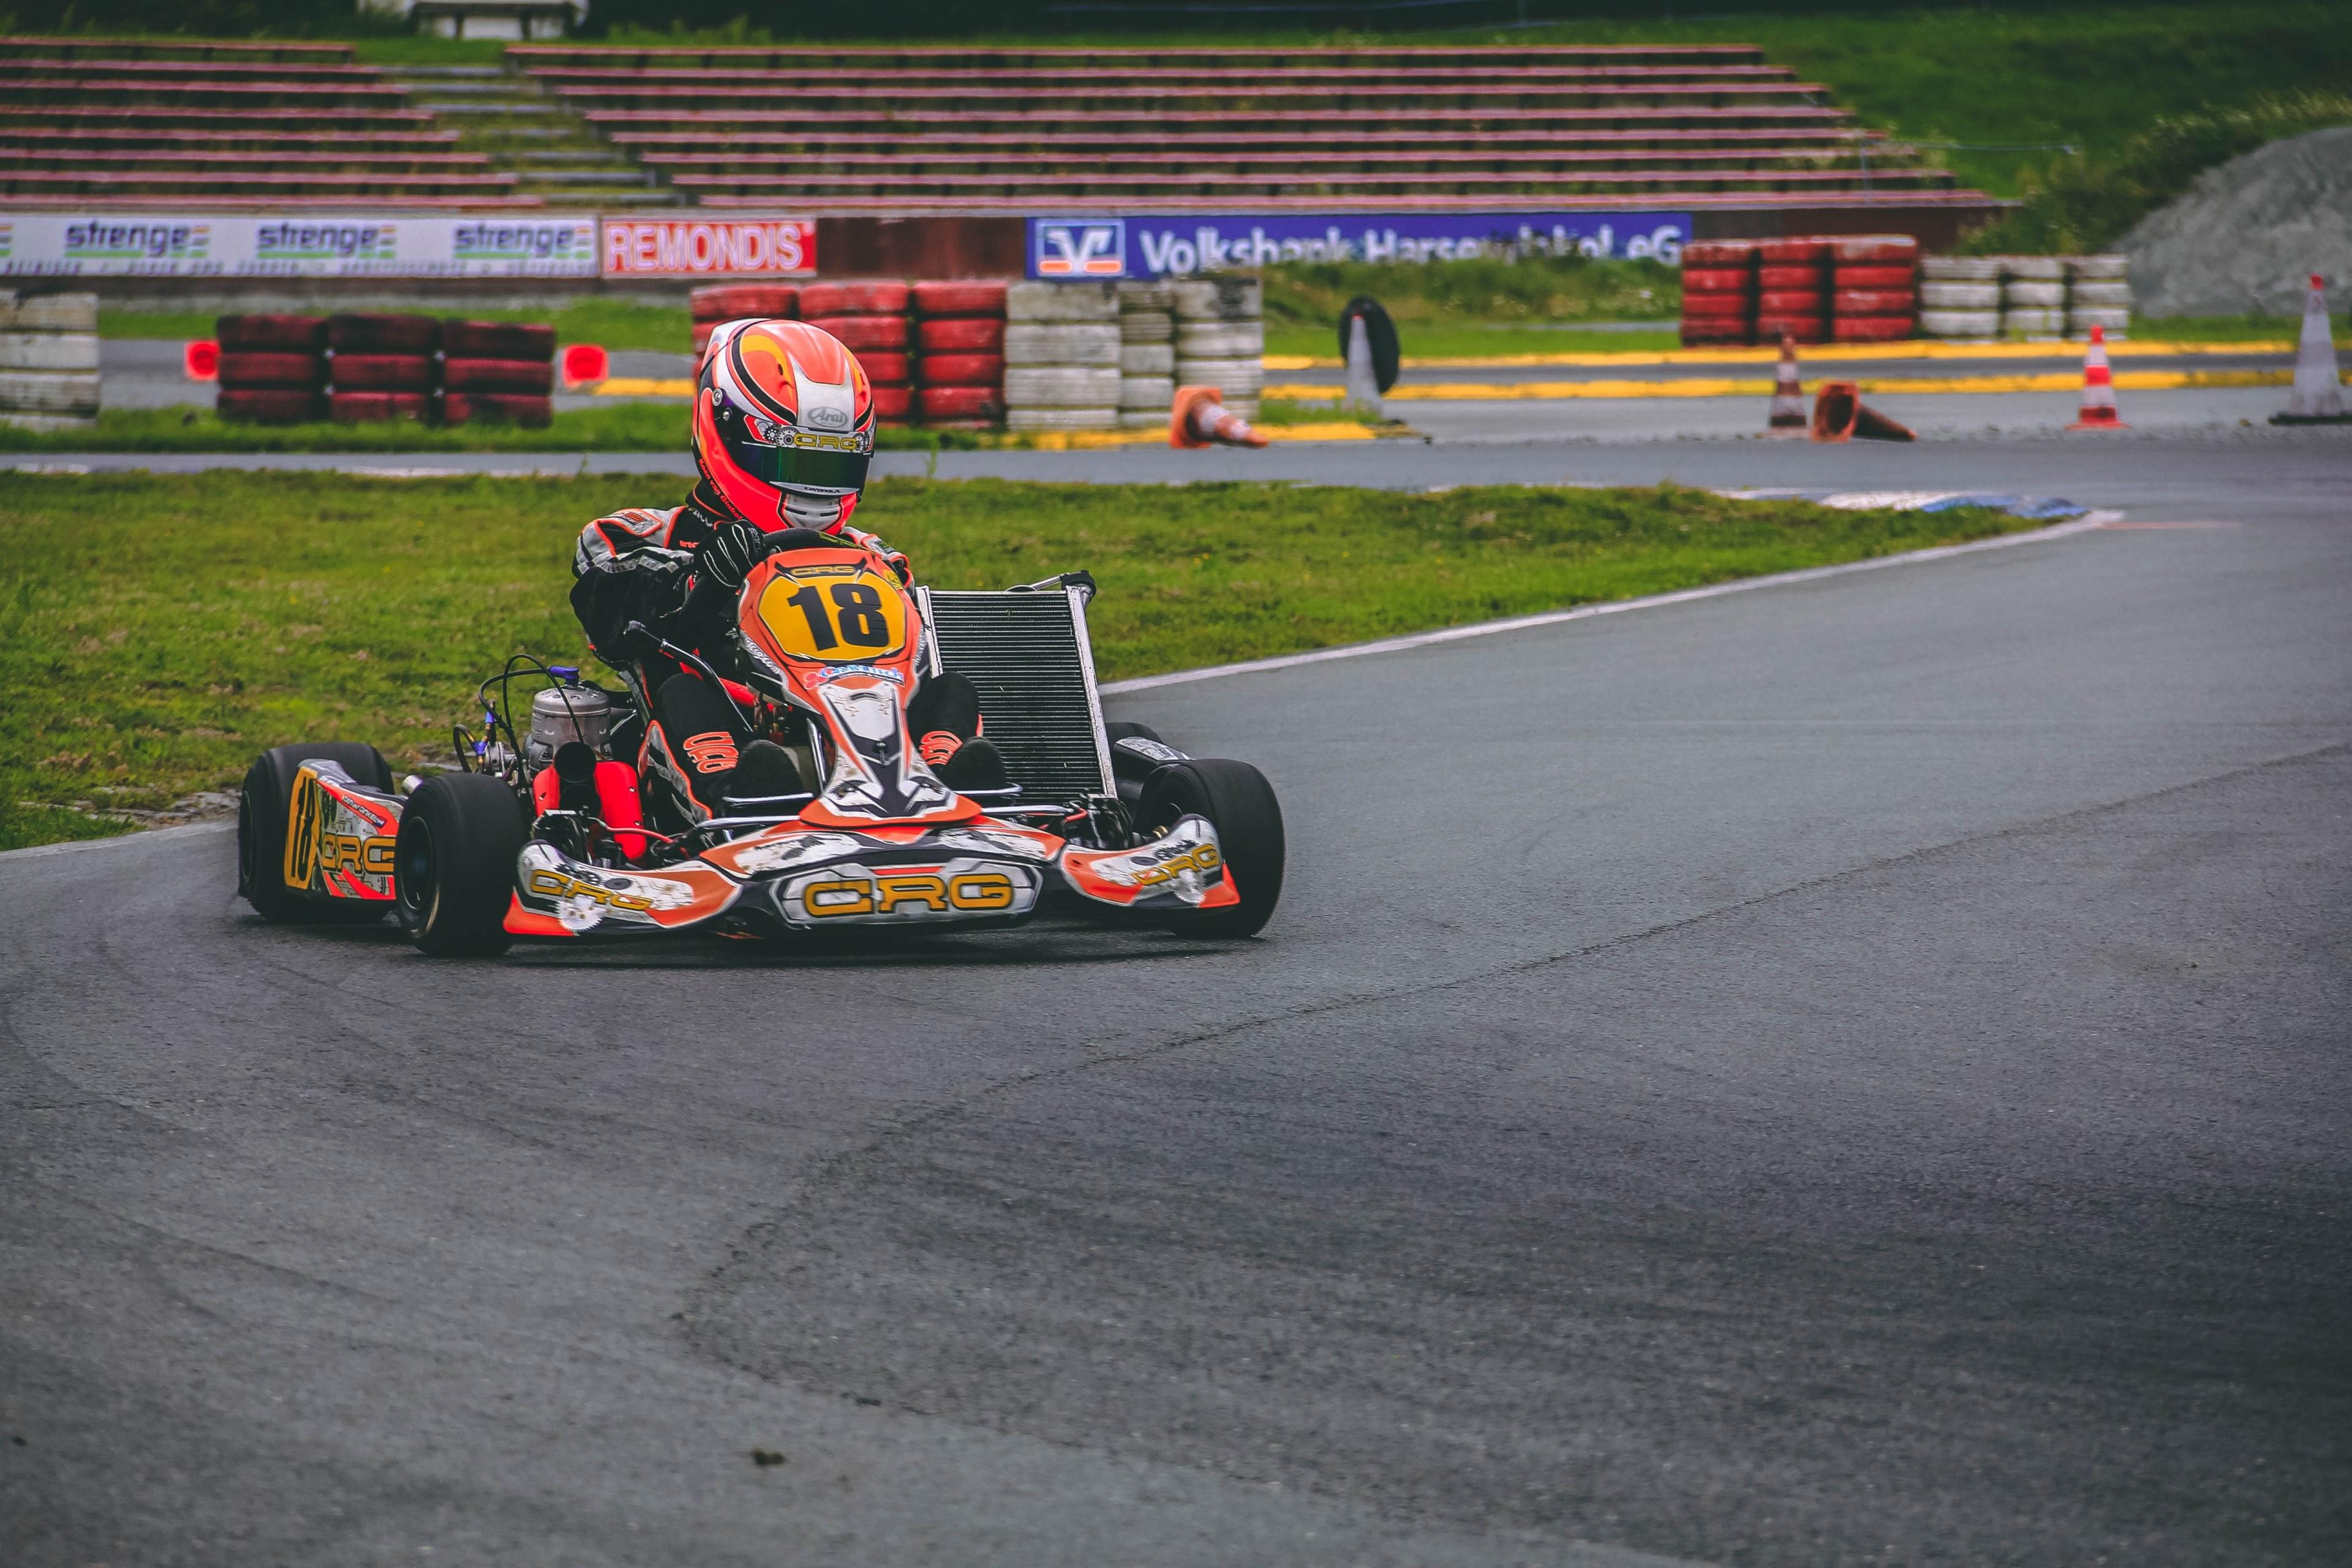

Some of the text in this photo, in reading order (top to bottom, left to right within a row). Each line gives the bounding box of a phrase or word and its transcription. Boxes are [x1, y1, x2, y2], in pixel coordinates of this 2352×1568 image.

[66, 219, 190, 257] strenge
[256, 219, 379, 258] strenge
[454, 220, 575, 258] strenge
[608, 227, 804, 270] REMONDIS
[810, 407, 845, 423] Arai
[793, 432, 858, 450] CRG
[790, 565, 856, 576] CRG
[788, 583, 889, 651] 18
[290, 777, 315, 881] 18
[322, 832, 397, 875] CRG
[1131, 843, 1220, 886] CRG
[530, 869, 655, 911] CRG
[804, 873, 1013, 918] CRG
